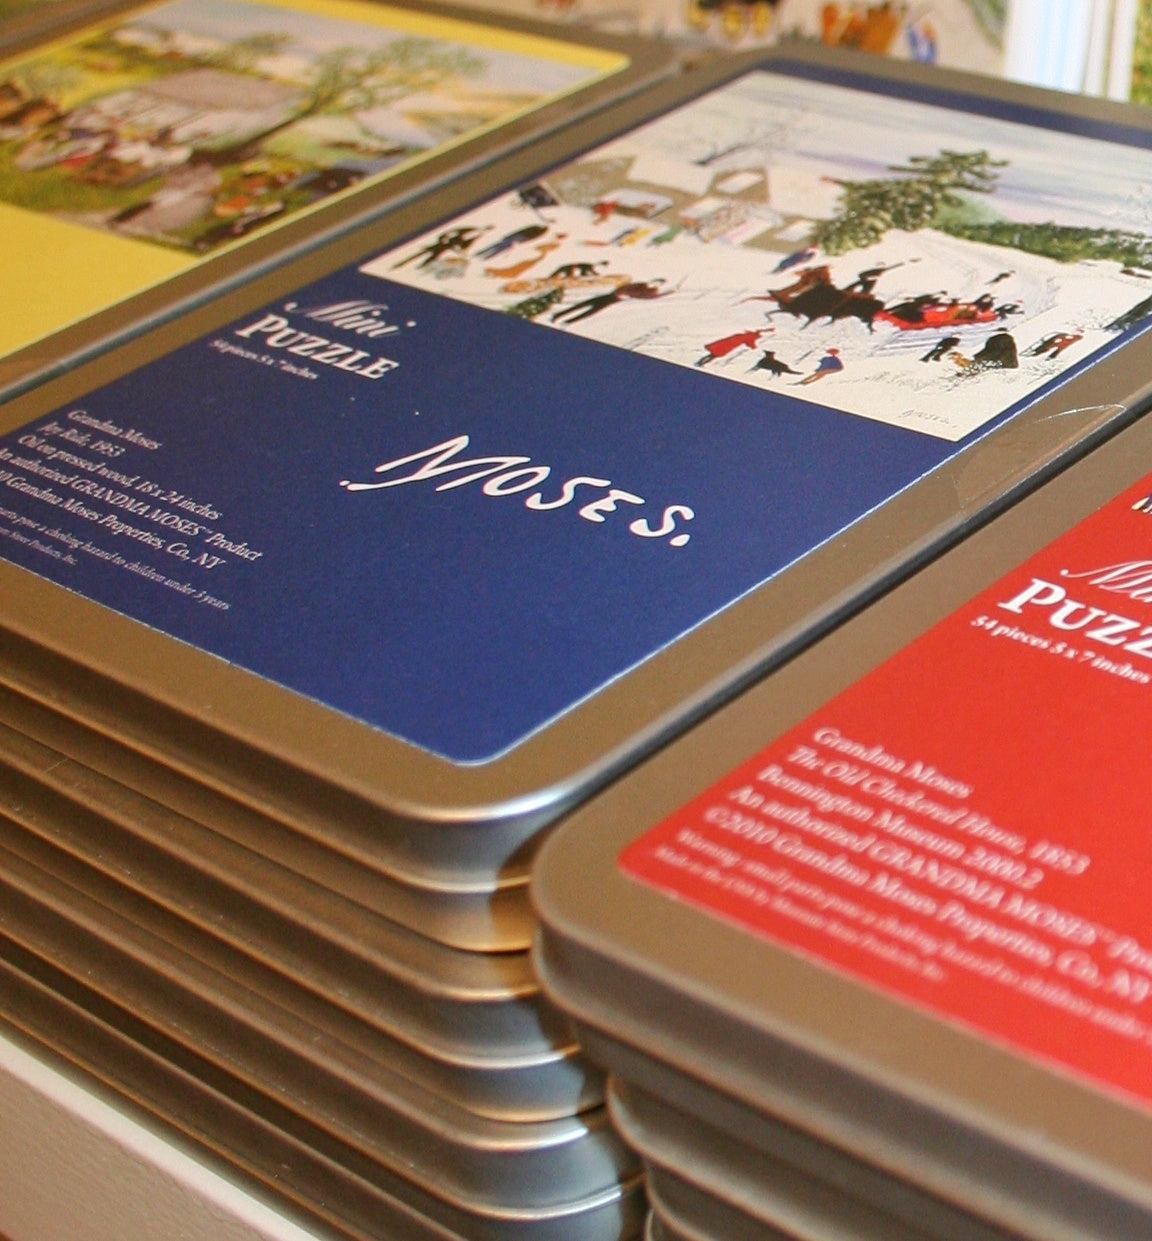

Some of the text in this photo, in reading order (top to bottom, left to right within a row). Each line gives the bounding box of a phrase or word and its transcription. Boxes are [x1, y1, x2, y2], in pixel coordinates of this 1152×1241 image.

[284, 299, 417, 339] Mini
[235, 313, 400, 380] PUZZLE
[17, 434, 46, 449] Oil
[36, 443, 57, 456] on
[67, 409, 162, 450] Grandma Moses
[89, 440, 126, 458] 1953
[46, 450, 107, 473] pressed
[97, 466, 141, 488] wood,
[134, 480, 159, 494] 18
[160, 490, 185, 505] 24
[5, 476, 64, 507] Grandma
[61, 497, 104, 521] Moses
[97, 513, 166, 550] Properties,
[191, 552, 227, 570] NY
[9, 456, 80, 486] authorized
[70, 478, 151, 516] GRANDMA
[204, 532, 264, 561] Product
[177, 497, 223, 520] inches
[971, 615, 998, 630] 54
[991, 621, 1051, 650] pieces
[1063, 648, 1080, 660] x
[1092, 656, 1152, 684] inches
[813, 727, 974, 799] Grandma Moses
[787, 745, 825, 771] The
[822, 760, 871, 786] Old
[860, 774, 970, 826] Checkered
[756, 763, 875, 822] Bennington
[868, 809, 966, 861] Museum
[728, 785, 766, 809] An
[761, 800, 878, 853] authorized
[867, 840, 1006, 909] GRANDMA
[771, 834, 871, 886] Grandma
[863, 871, 939, 917] Moses
